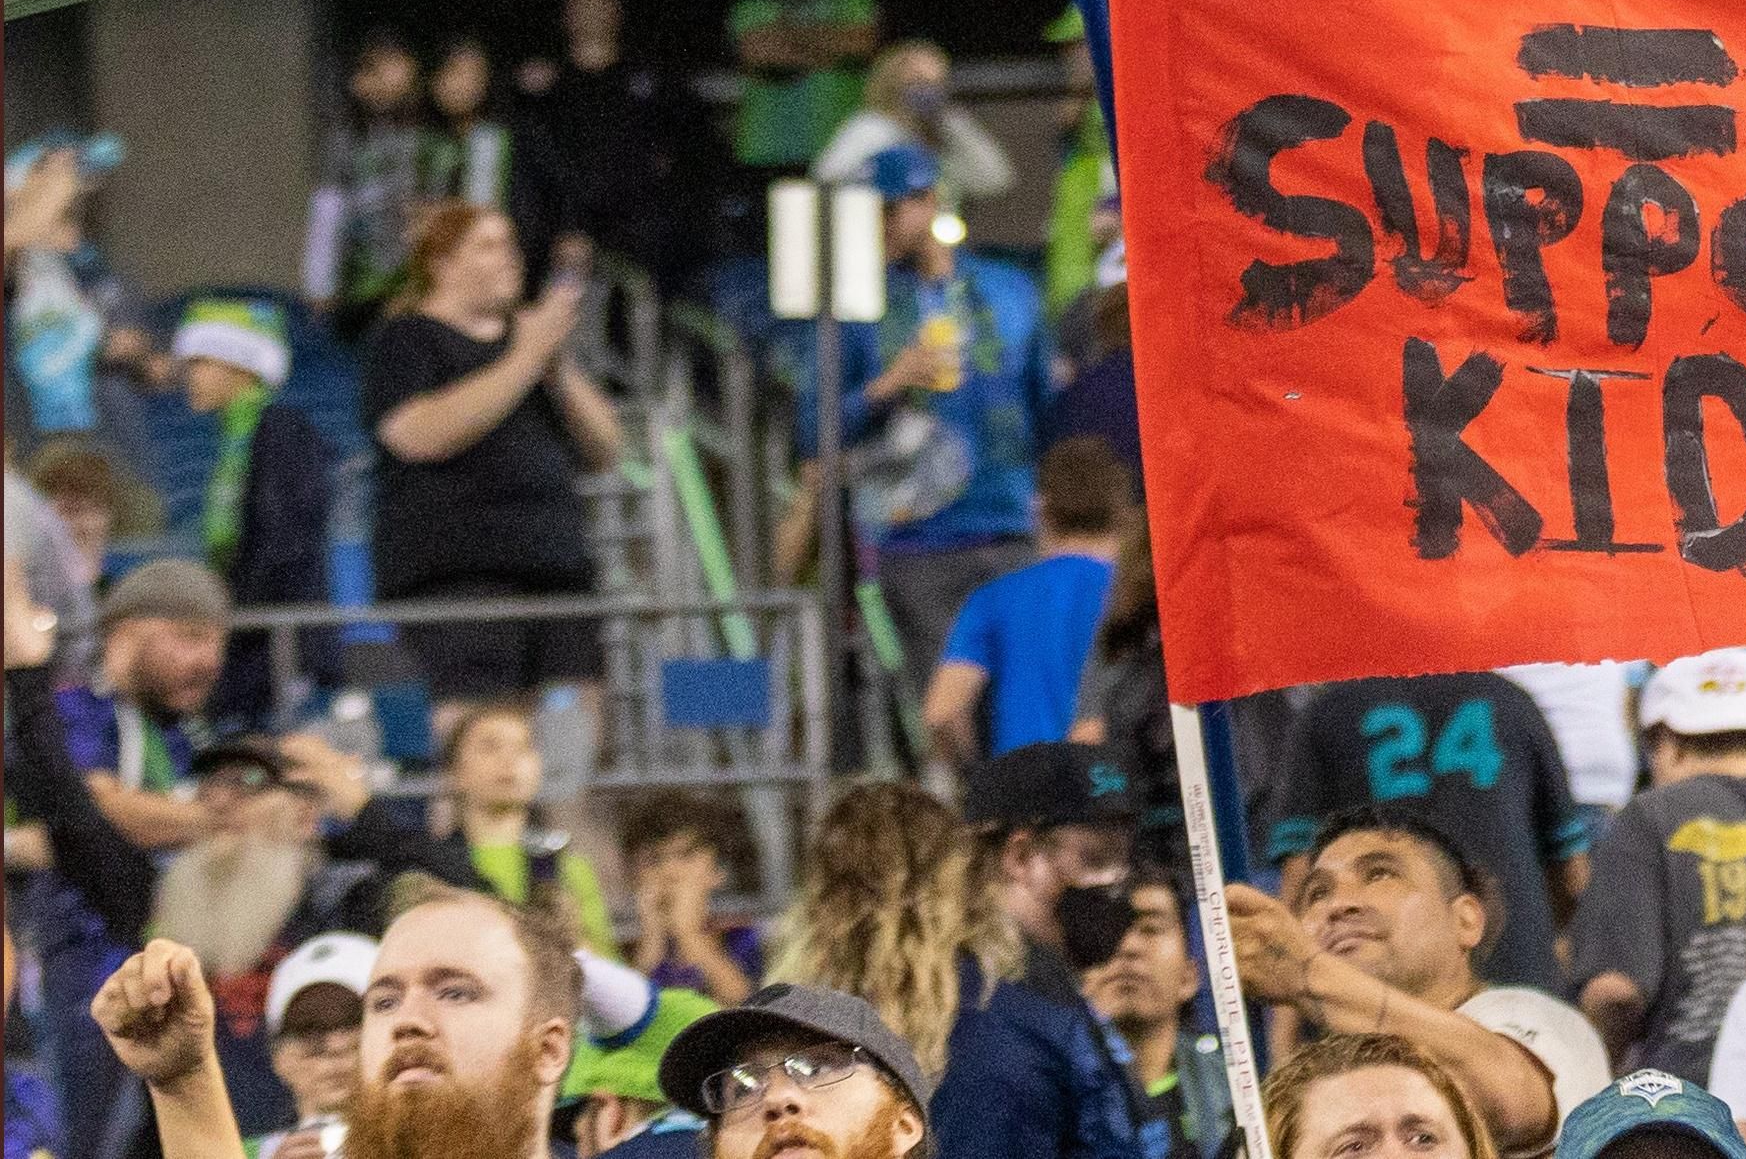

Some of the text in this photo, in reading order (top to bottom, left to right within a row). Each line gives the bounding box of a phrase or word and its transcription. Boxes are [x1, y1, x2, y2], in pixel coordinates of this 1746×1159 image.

[1360, 697, 1504, 802] 24
[1207, 889, 1256, 1093] CHARLOTTE PIPE
